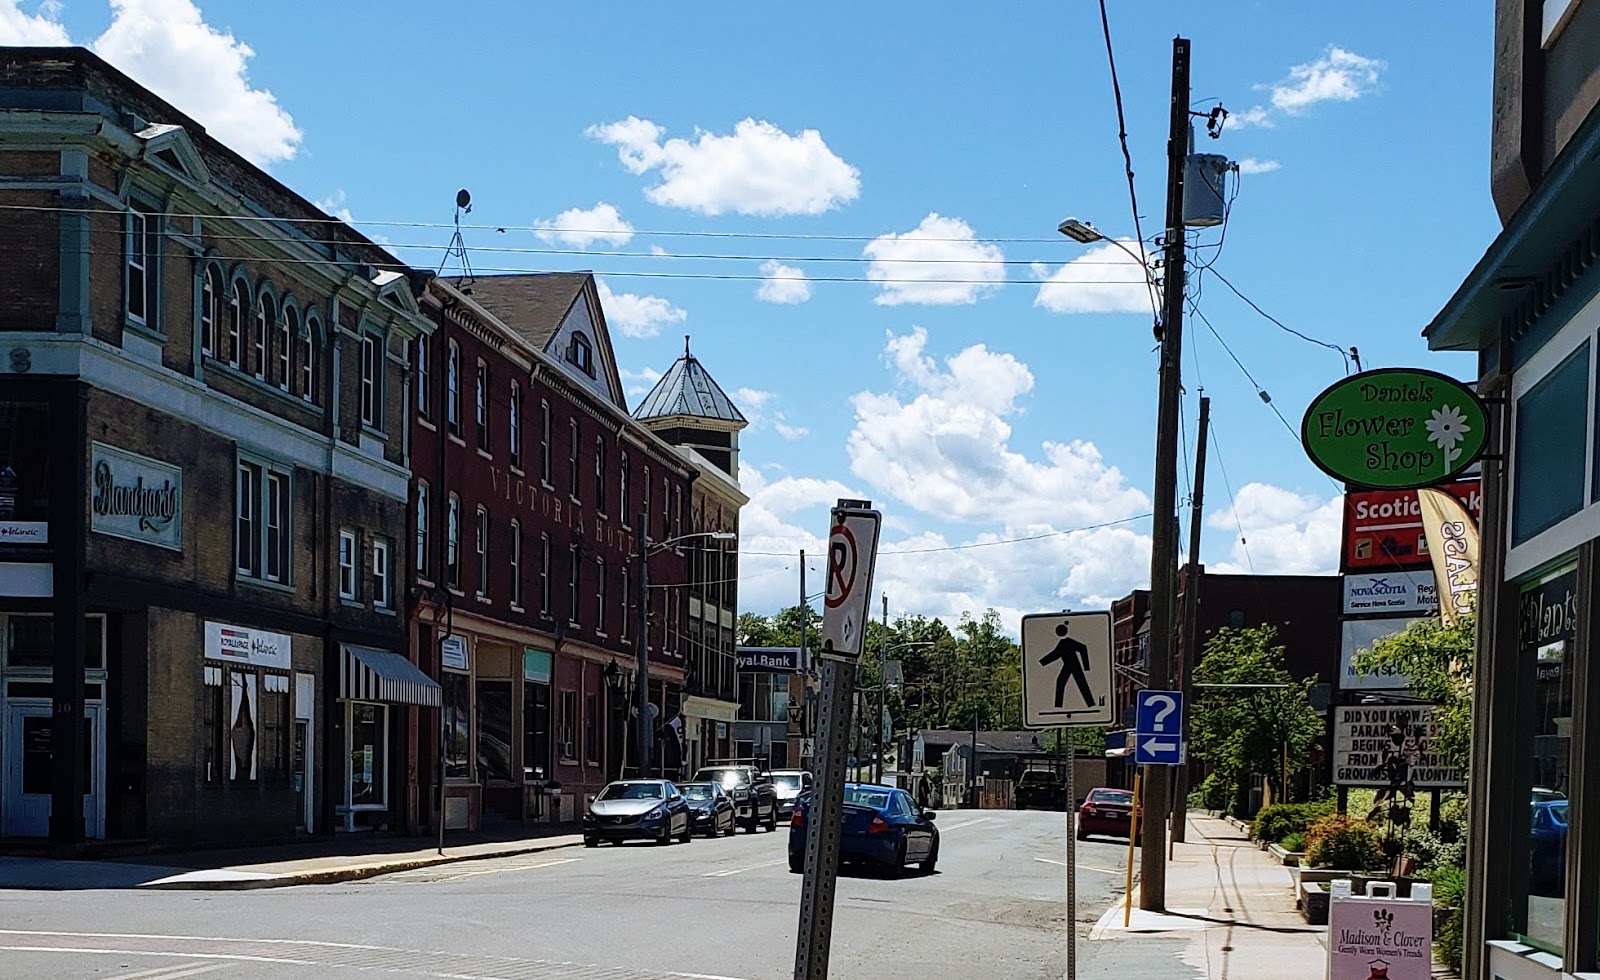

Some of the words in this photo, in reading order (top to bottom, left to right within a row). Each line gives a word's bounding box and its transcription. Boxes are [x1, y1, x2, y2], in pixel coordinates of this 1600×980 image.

[1360, 381, 1433, 402] Daniels
[1318, 408, 1414, 438] Flower
[1366, 441, 1434, 476] Shop
[490, 466, 584, 534] VICTORIA
[596, 519, 637, 556] HOTE
[1356, 489, 1480, 520] Scotiak
[1351, 587, 1374, 596] NOVA
[1375, 584, 1407, 595] SCOTIA
[1417, 595, 1438, 605] Moto
[760, 655, 790, 667] Bank
[1344, 710, 1362, 723] DID
[1363, 710, 1387, 723] YOU
[1351, 725, 1394, 738] PARAD
[1352, 739, 1391, 751] BEGINS
[1348, 754, 1378, 765] FROM
[1411, 768, 1462, 780] AVONVIE
[1339, 929, 1380, 946] Madison
[1383, 931, 1392, 946] &
[1393, 931, 1425, 948] Clover
